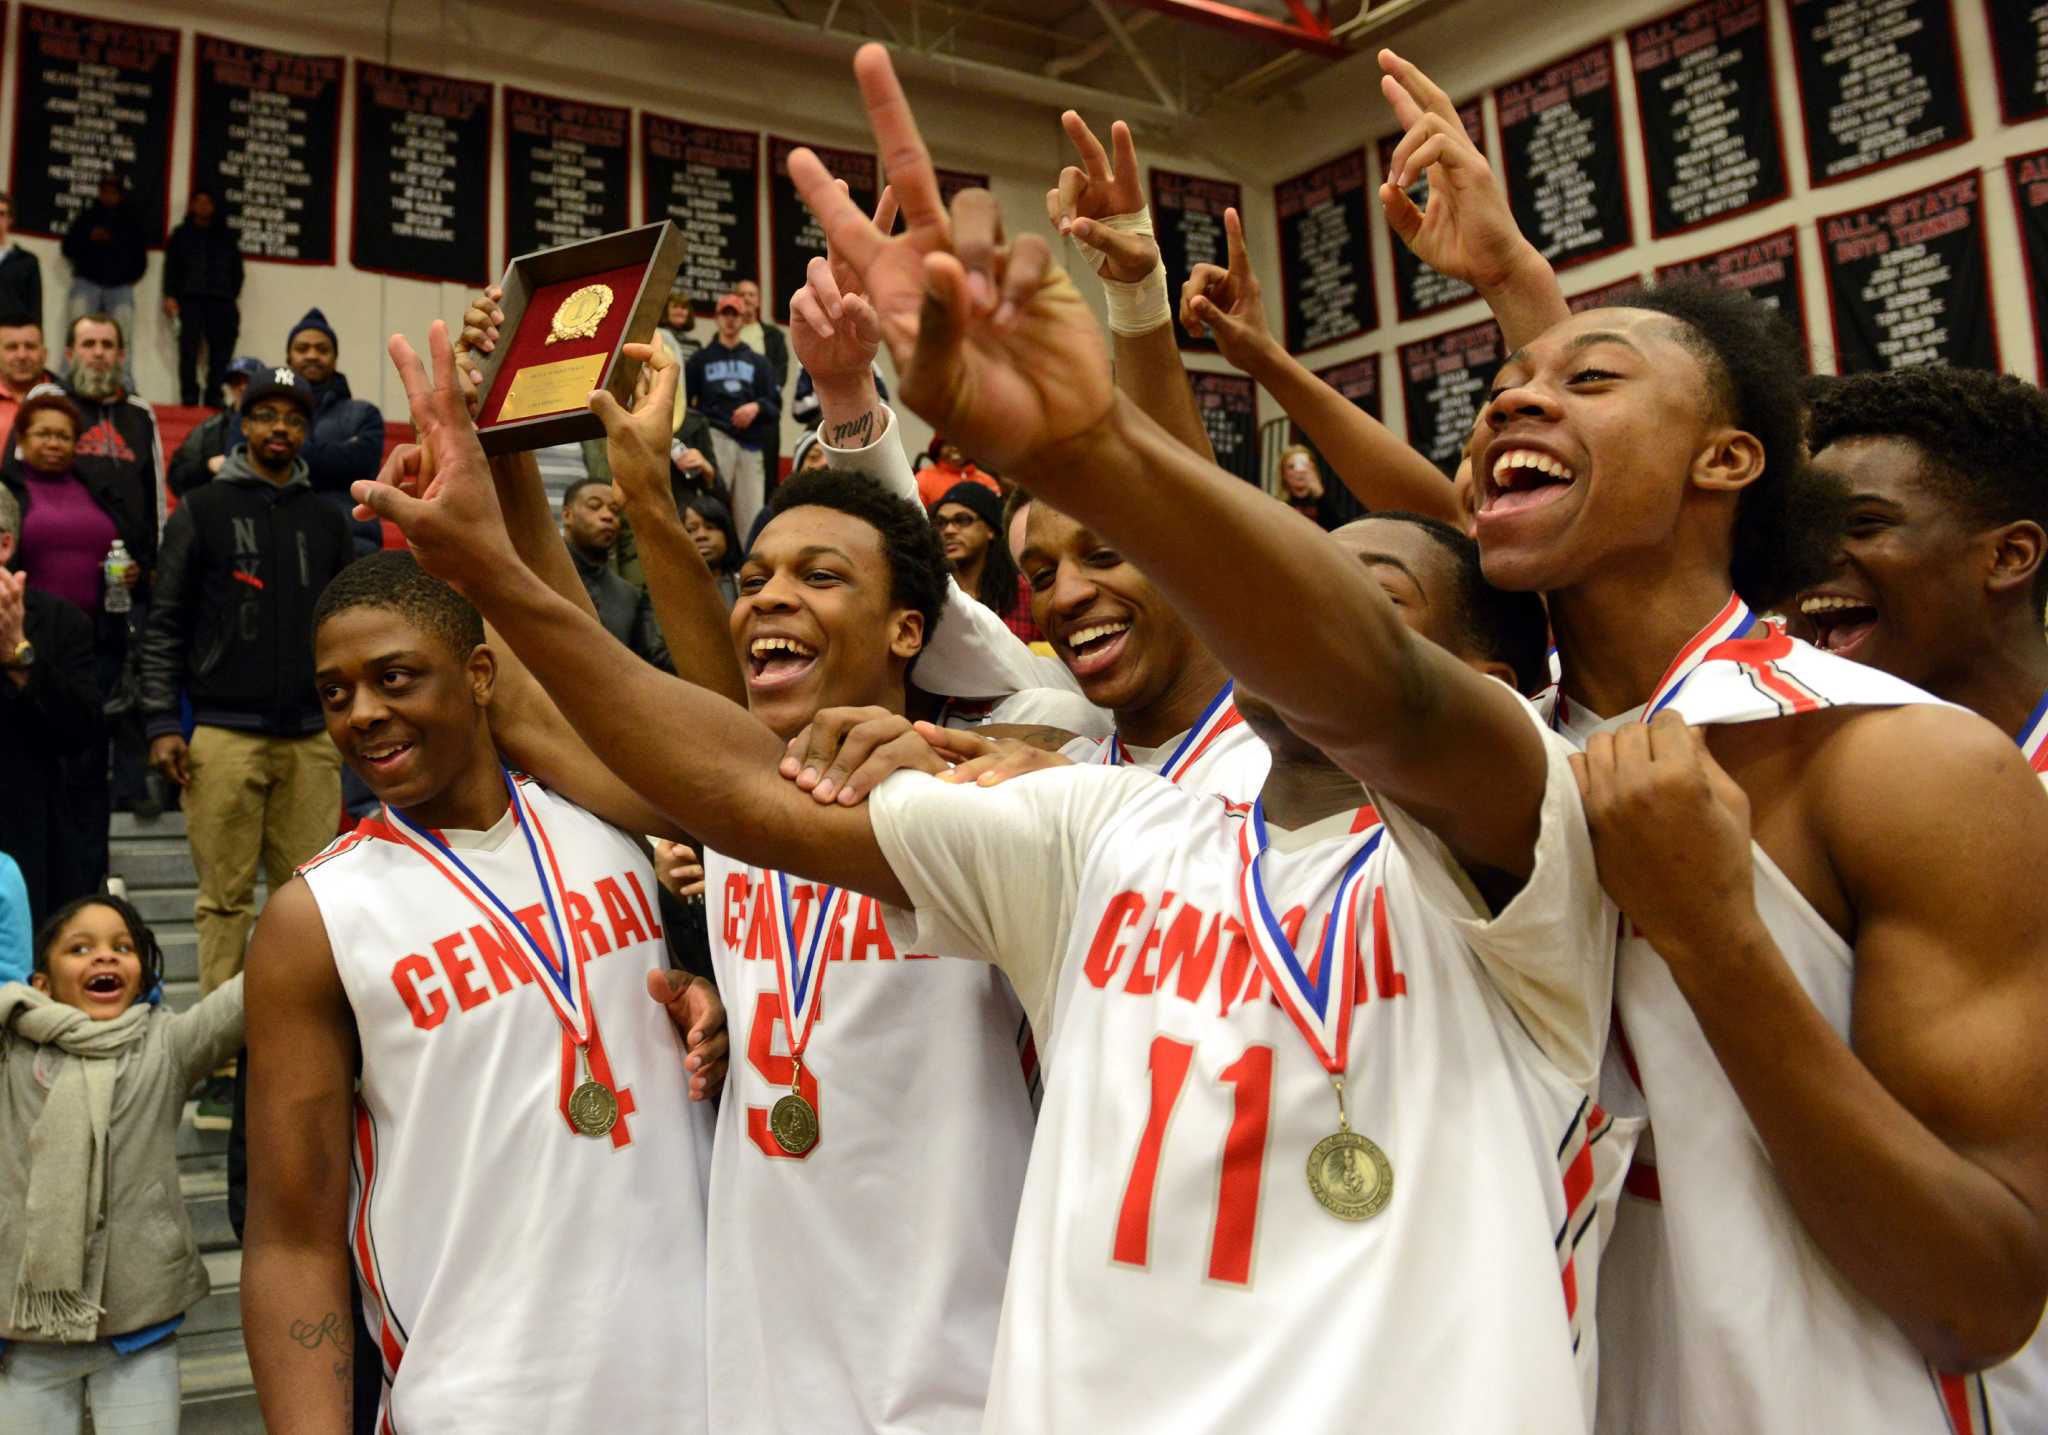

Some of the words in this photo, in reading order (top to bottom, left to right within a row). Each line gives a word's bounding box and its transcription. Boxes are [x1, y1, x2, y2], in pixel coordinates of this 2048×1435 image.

[1827, 178, 1979, 242] ALL-STATE
[1835, 231, 1890, 265] BOYS
[1895, 206, 1971, 245] TENNIS
[390, 871, 664, 1031] CENTRAL
[1108, 1033, 1277, 1288] 11
